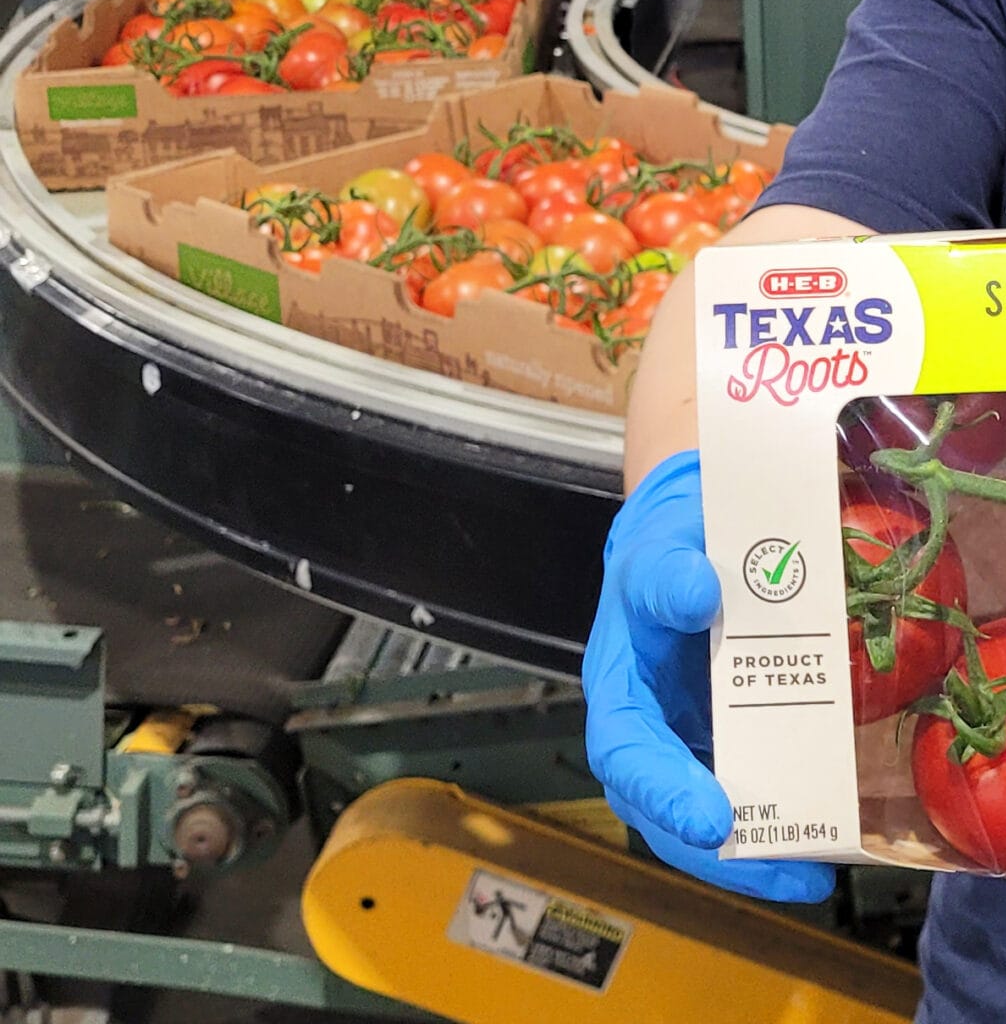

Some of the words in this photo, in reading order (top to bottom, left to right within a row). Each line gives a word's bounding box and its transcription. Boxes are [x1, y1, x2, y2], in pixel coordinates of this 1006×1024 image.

[770, 275, 836, 292] H-E-B
[713, 298, 893, 349] TEXAS
[749, 545, 785, 574] SELECT
[733, 654, 823, 668] PRODUCT
[732, 674, 756, 687] OF
[765, 672, 827, 687] TEXAS
[733, 805, 755, 822] NET
[758, 803, 780, 821] WT.
[733, 828, 747, 844] 16
[750, 827, 765, 843] OZ
[768, 825, 778, 844] (1
[781, 823, 800, 842] LB)
[803, 823, 826, 840] 454
[830, 825, 838, 842] g
